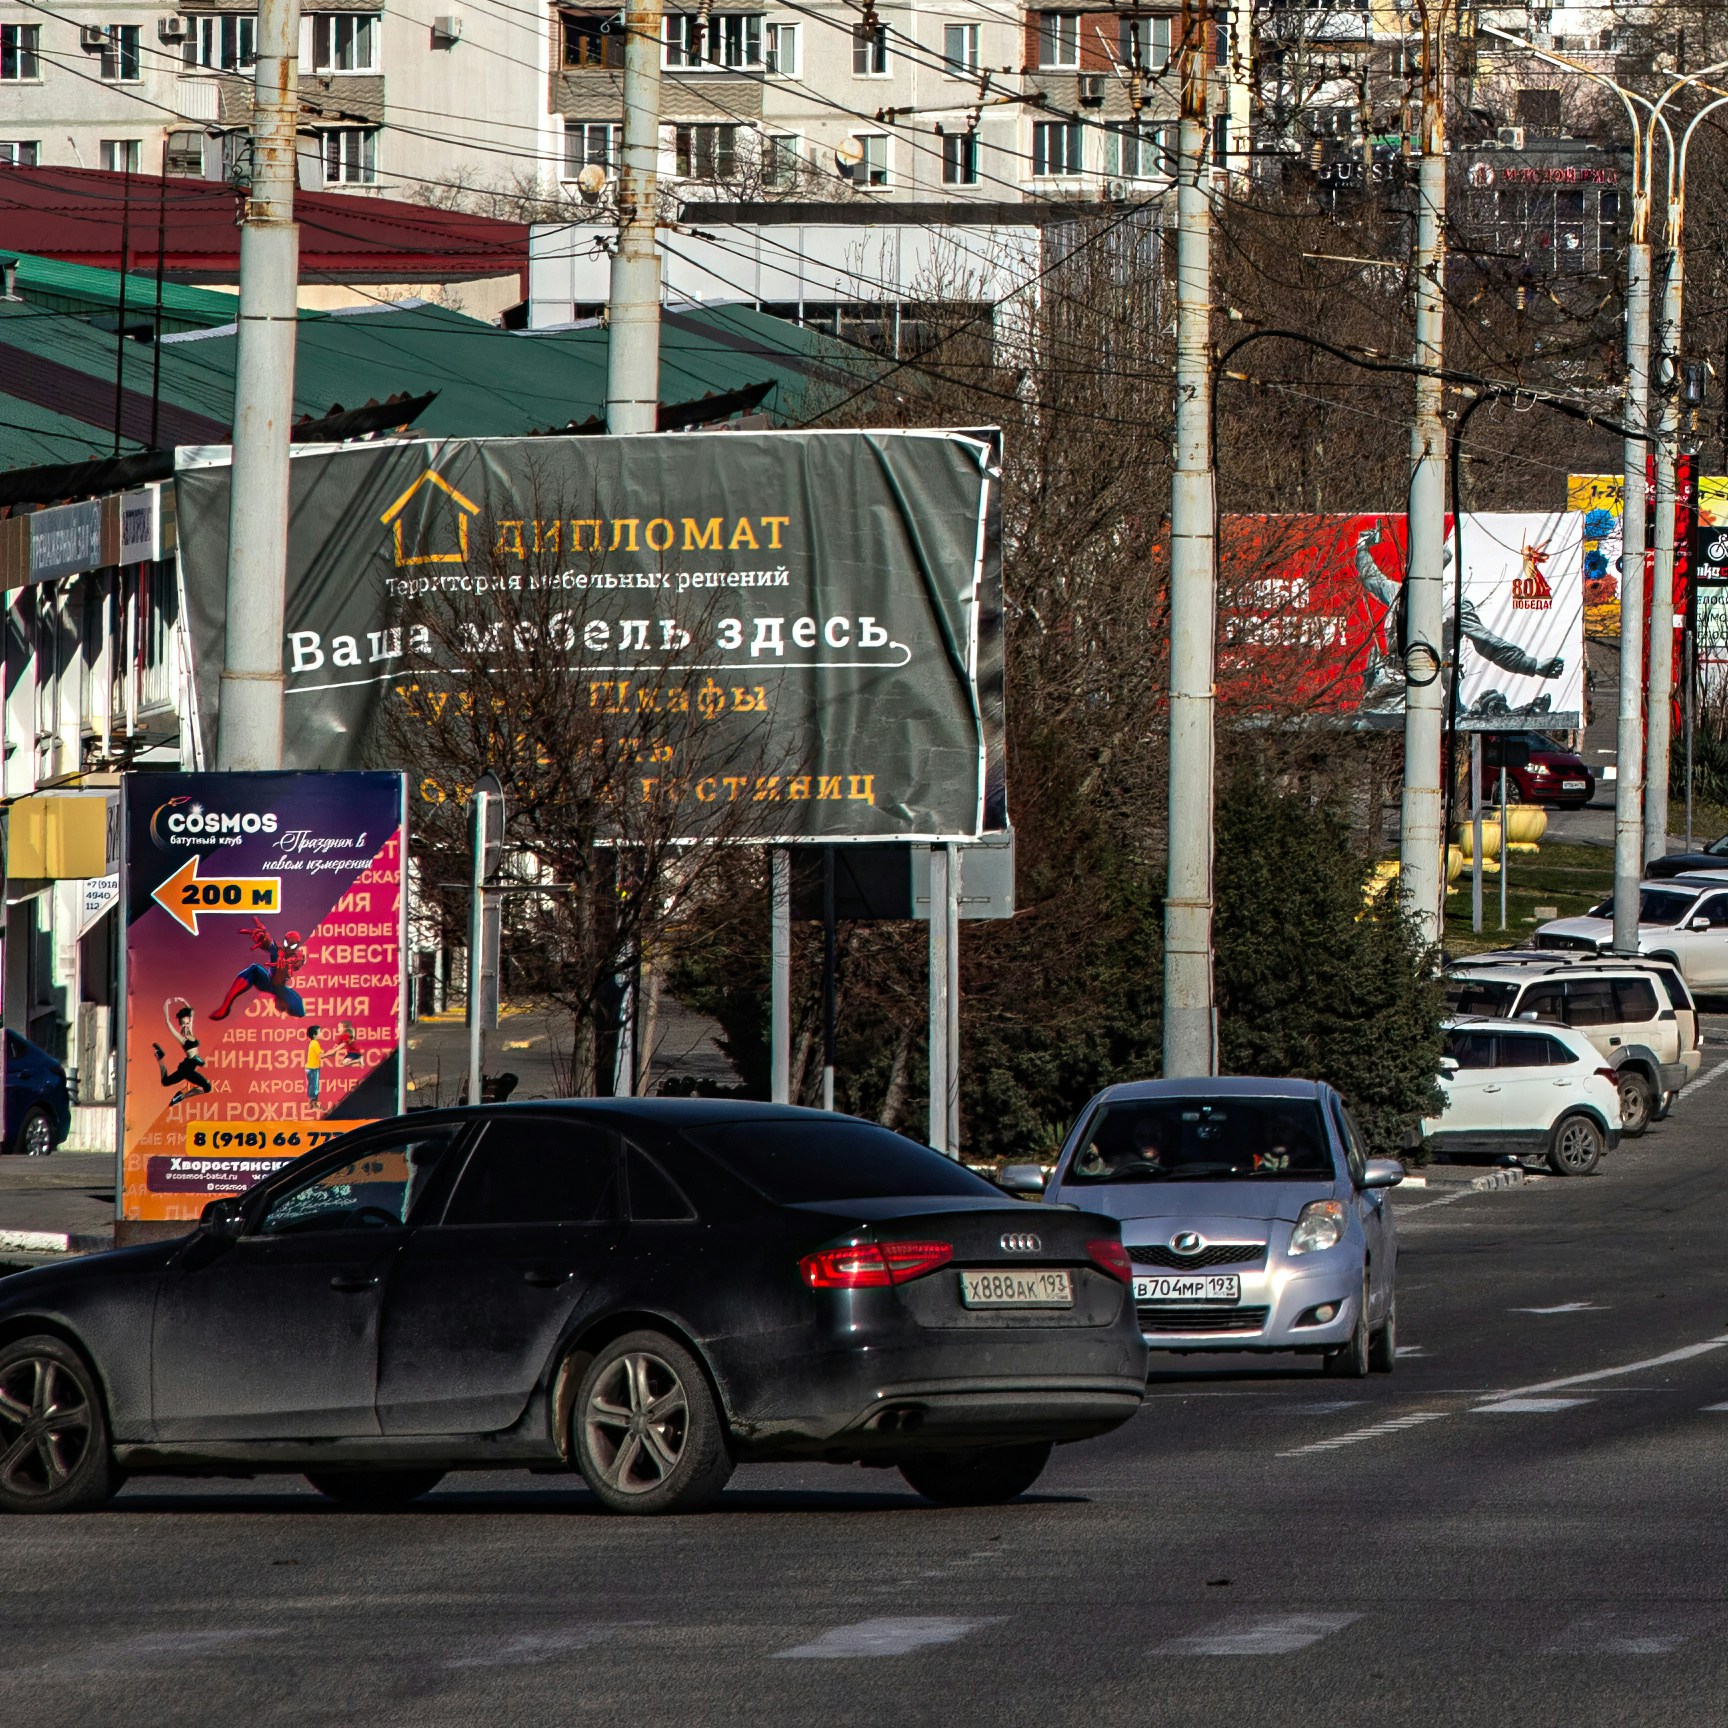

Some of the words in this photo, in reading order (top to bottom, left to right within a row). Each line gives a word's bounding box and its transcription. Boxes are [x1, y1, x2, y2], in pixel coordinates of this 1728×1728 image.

[496, 516, 790, 559] ДИПЛОМАТ
[678, 566, 790, 592] решений
[286, 624, 432, 673] Ваша
[460, 609, 692, 655] мебель
[589, 677, 769, 720] Шкафы
[168, 813, 278, 833] COSMOS
[170, 835, 216, 847] батутный
[219, 835, 243, 847] клуб
[272, 830, 354, 853] Праздник
[262, 855, 304, 871] новом
[306, 858, 373, 875] измерении
[182, 884, 242, 905] 200
[252, 888, 273, 906] м
[223, 1028, 257, 1042] ДВЕ
[166, 1102, 218, 1122] ДНИ
[193, 1131, 206, 1147] 8
[212, 1131, 267, 1150] (918)
[272, 1131, 301, 1147] 66
[969, 1275, 1037, 1300] Х888АК
[1038, 1274, 1067, 1293] 193
[1137, 1279, 1205, 1297] В704МР
[1208, 1277, 1235, 1292] 193
